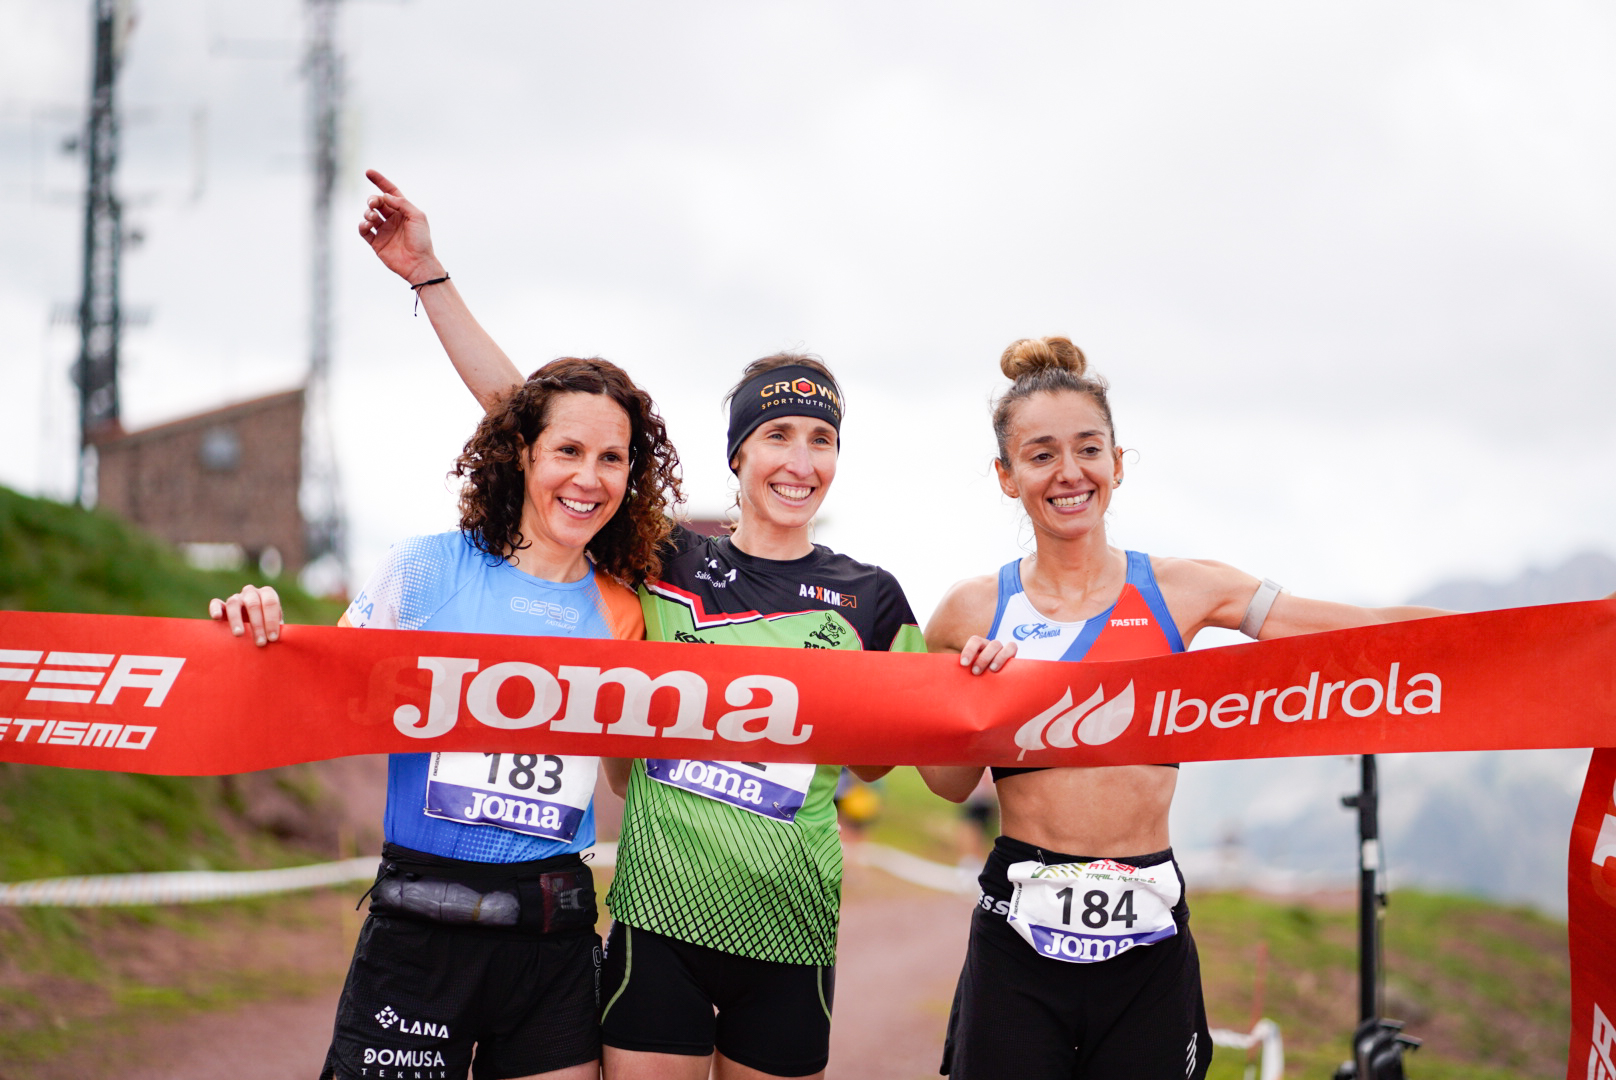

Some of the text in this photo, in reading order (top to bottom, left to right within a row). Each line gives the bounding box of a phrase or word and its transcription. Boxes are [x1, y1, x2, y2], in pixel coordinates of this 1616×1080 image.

[761, 398, 794, 411] SPORT
[799, 583, 841, 606] A4XKM
[1110, 618, 1149, 628] FASTER
[1147, 661, 1443, 736] Iberdrola
[484, 753, 564, 795] 183
[1055, 886, 1138, 930] 184
[400, 1018, 450, 1039] LANA
[363, 1047, 446, 1068] DOMUSA
